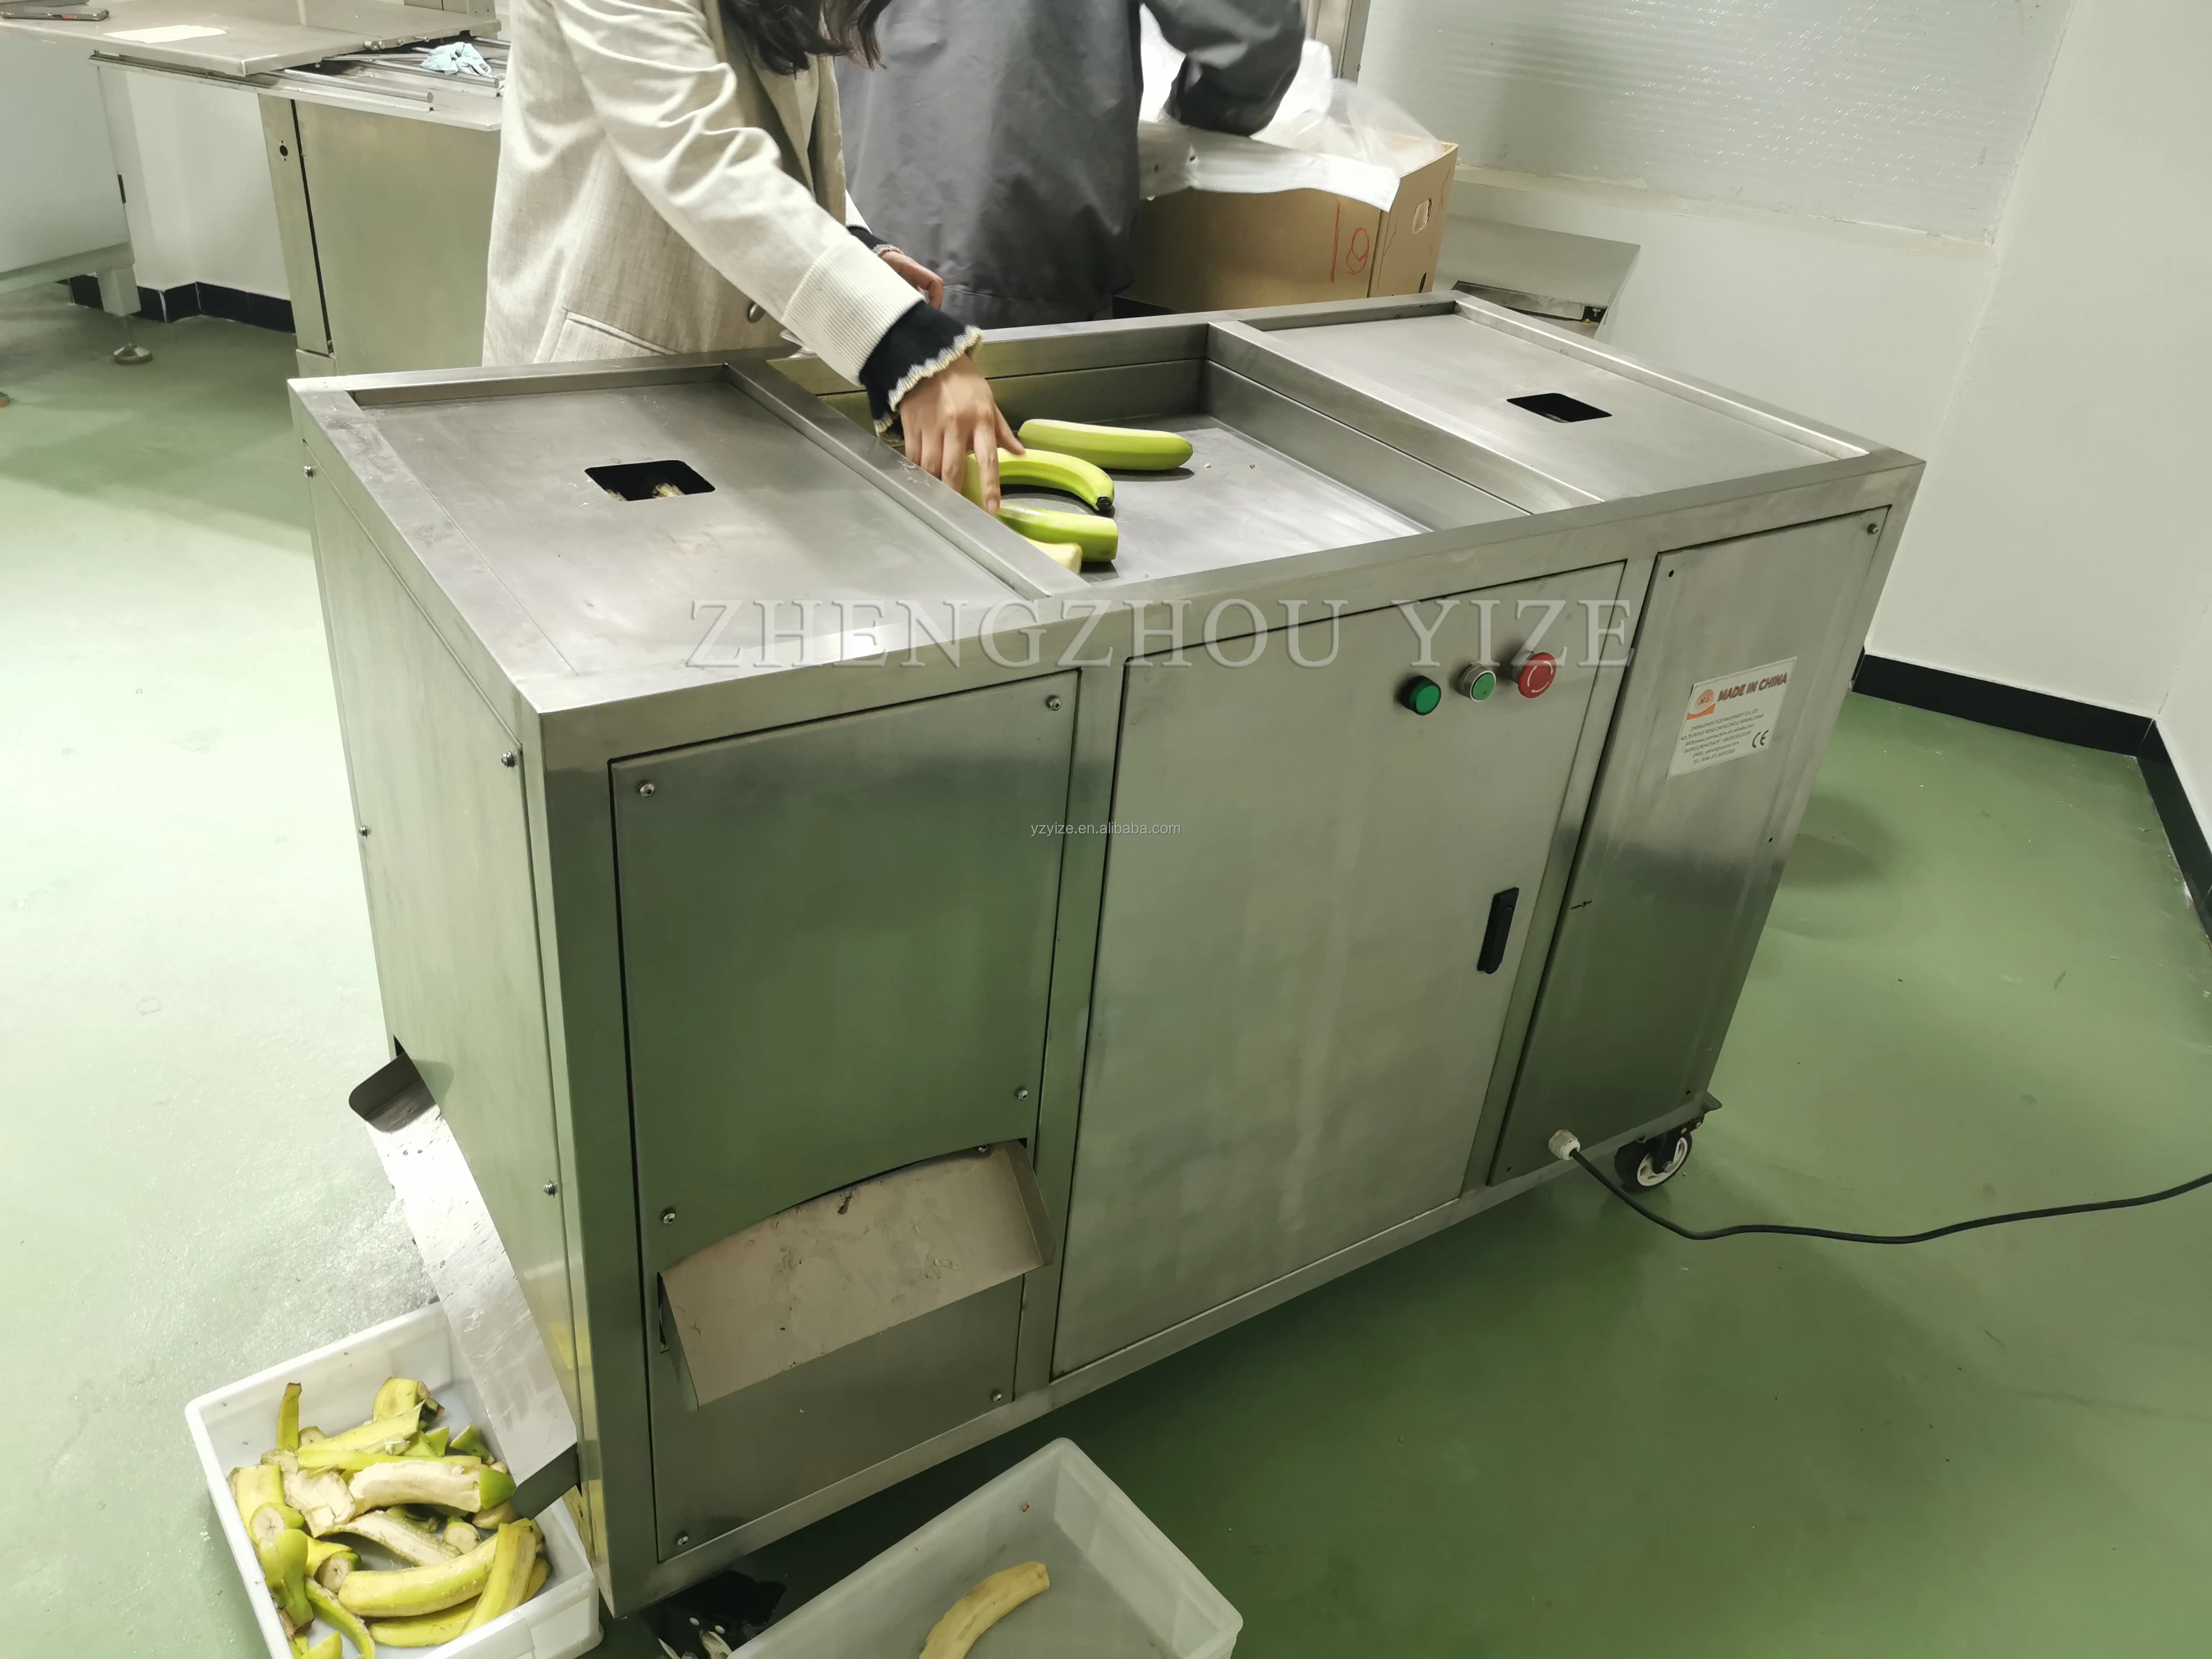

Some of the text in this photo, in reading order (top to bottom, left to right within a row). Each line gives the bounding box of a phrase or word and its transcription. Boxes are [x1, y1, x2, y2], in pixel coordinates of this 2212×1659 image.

[1717, 684, 1746, 701] MADE
[1746, 680, 1758, 694] IN
[1758, 672, 1788, 691] CHINA
[1752, 729, 1769, 748] CE
